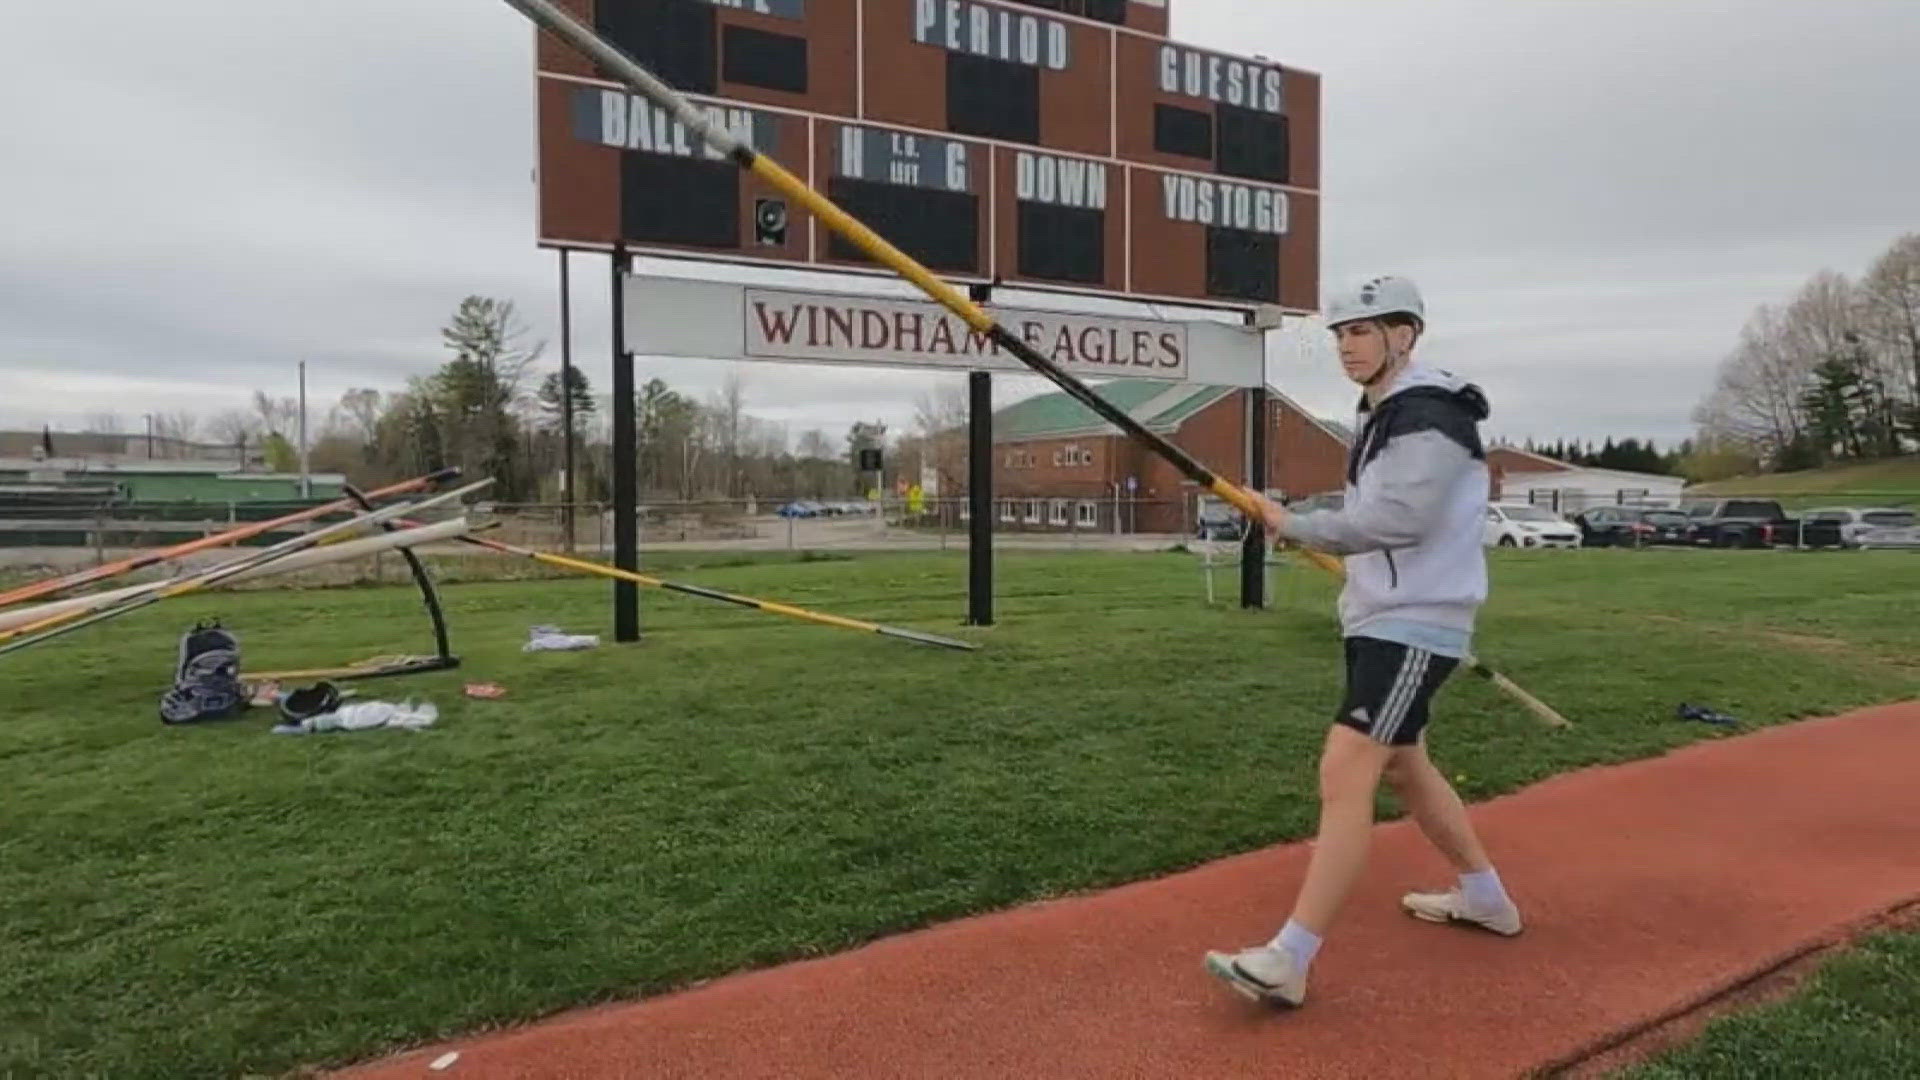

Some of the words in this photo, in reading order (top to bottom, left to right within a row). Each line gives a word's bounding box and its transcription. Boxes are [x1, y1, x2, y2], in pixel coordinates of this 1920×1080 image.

[916, 0, 1067, 70] PERIOD
[1161, 45, 1282, 112] GUESTS
[602, 90, 692, 156] BALL
[947, 141, 966, 191] G
[1017, 153, 1107, 209] DOWN
[1163, 174, 1213, 224] YDS
[1220, 184, 1249, 229] TO
[1255, 189, 1288, 234] GO
[753, 303, 999, 355] WINDHAM
[1021, 321, 1183, 368] EAGLES
